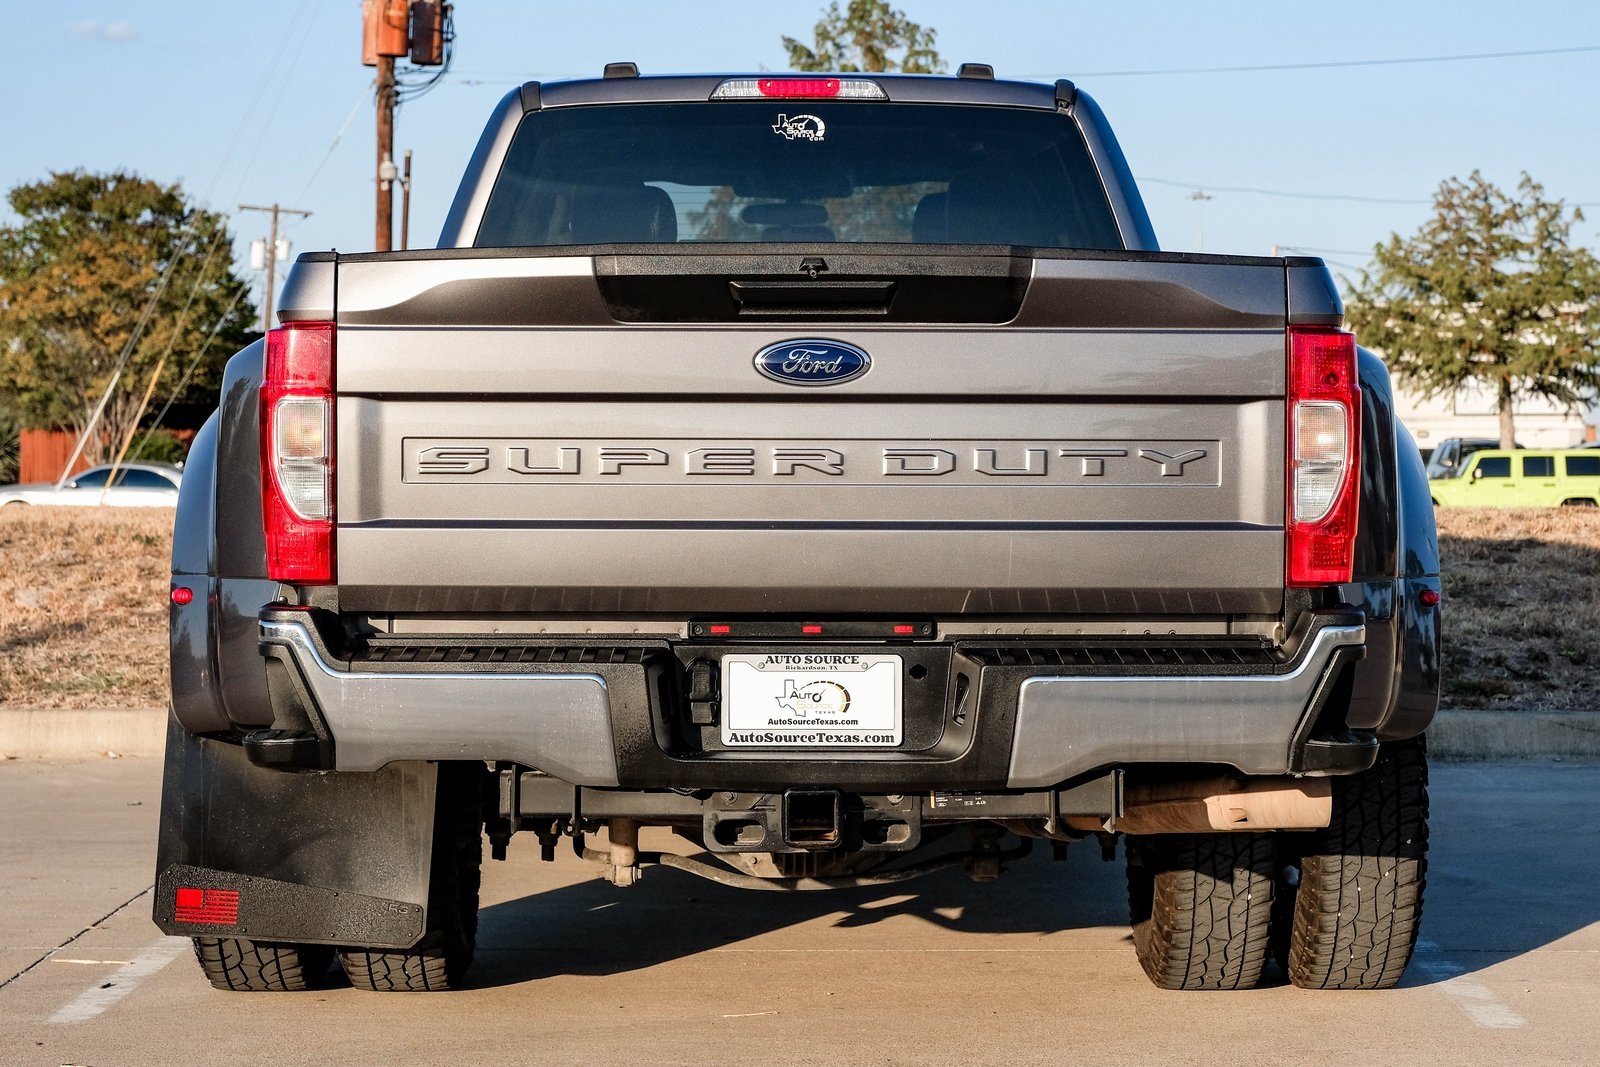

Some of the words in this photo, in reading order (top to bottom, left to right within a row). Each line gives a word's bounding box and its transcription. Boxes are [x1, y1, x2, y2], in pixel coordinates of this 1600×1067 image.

[782, 348, 843, 374] Ford
[418, 447, 845, 476] SUPER
[882, 448, 1207, 477] DUTY
[765, 655, 801, 665] AUTO
[804, 655, 860, 665] SOURCE
[767, 718, 859, 726] AutoSourceTexas.com
[729, 732, 895, 743] AutoSourceTexas.com
